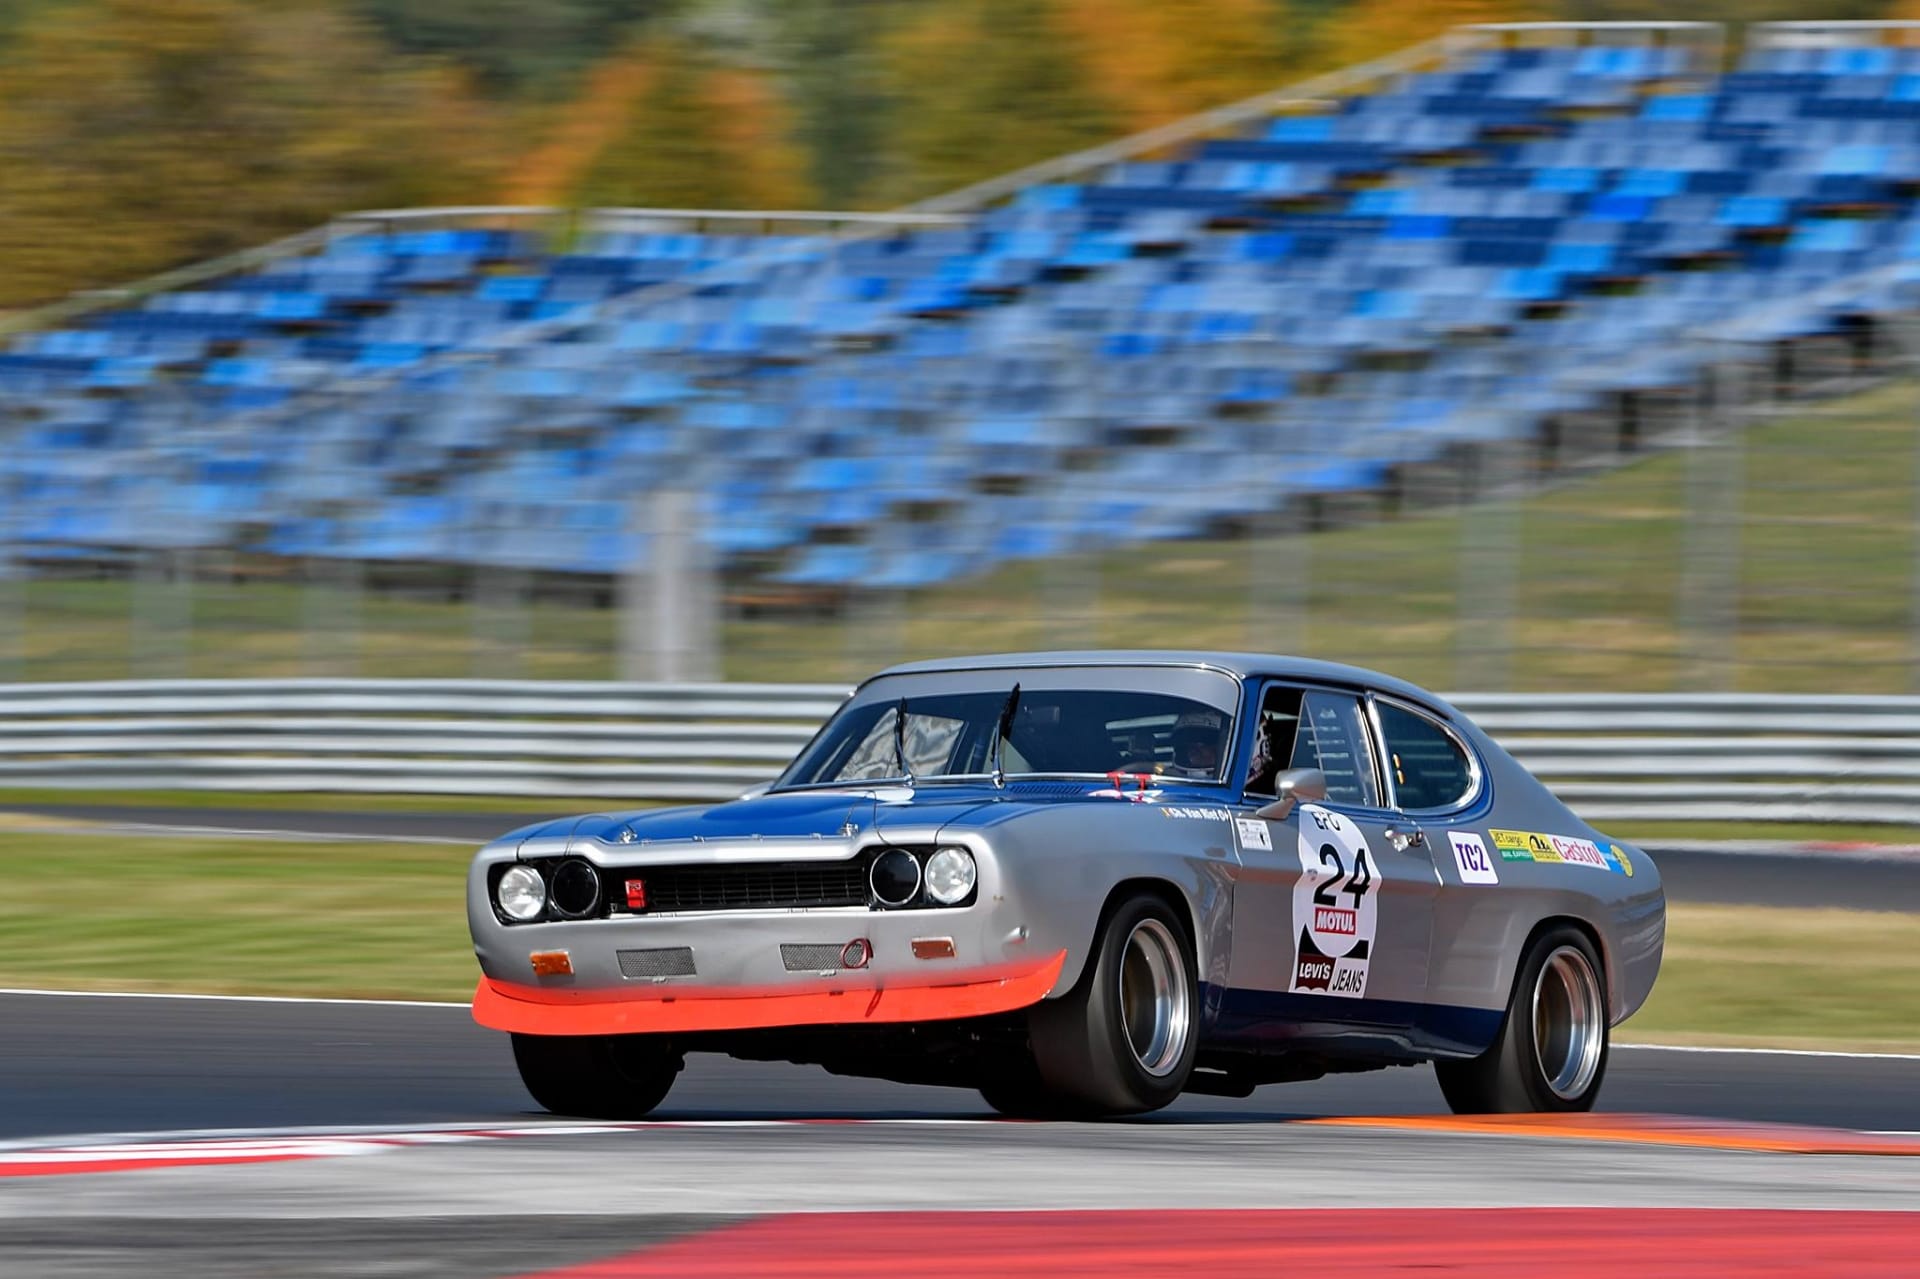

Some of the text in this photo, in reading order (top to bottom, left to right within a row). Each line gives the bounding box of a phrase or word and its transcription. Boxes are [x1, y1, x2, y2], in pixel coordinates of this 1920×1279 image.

[1455, 843, 1489, 871] TC2
[1552, 838, 1607, 866] Castrol
[1313, 843, 1371, 909] 24
[1316, 911, 1354, 932] MOTUL
[1299, 961, 1331, 979] Levi's
[1332, 967, 1364, 993] JEANS
